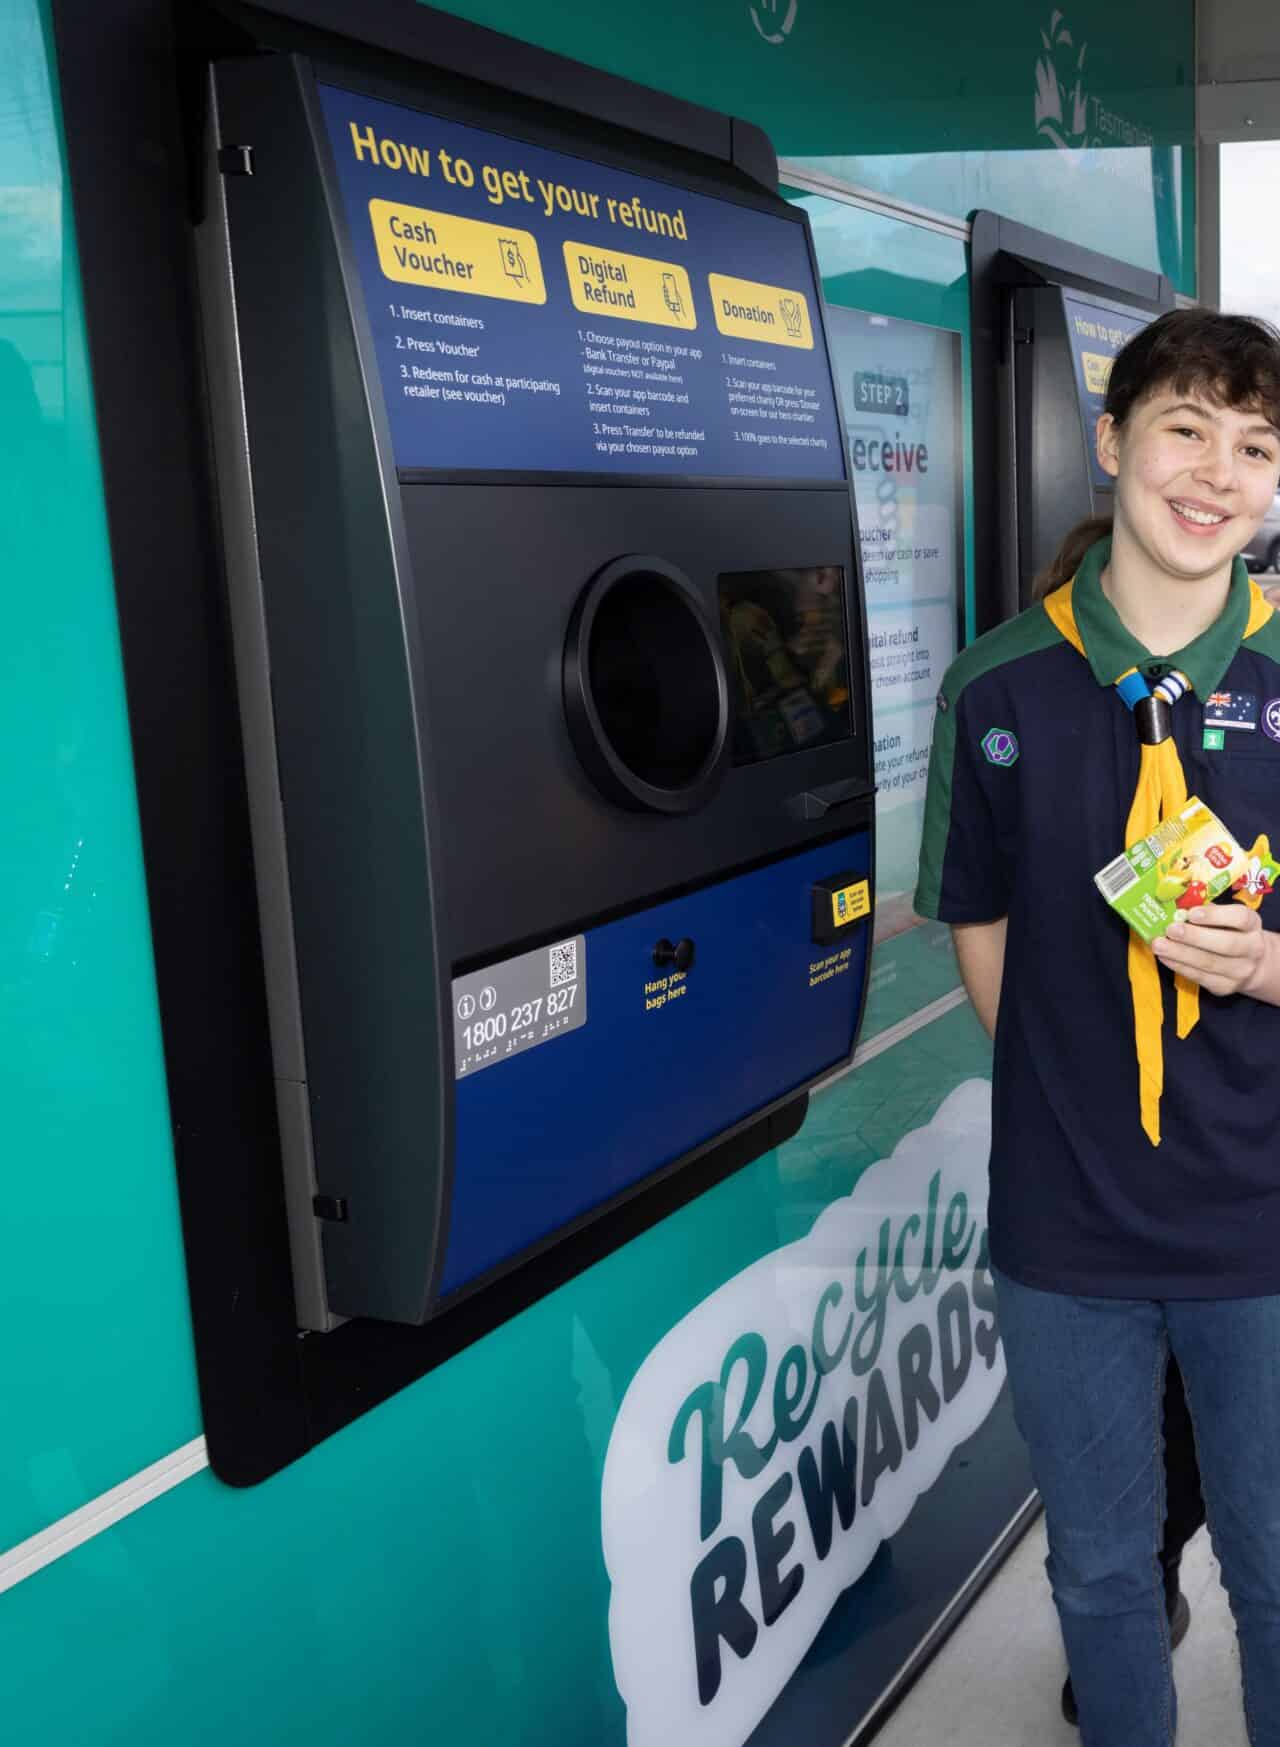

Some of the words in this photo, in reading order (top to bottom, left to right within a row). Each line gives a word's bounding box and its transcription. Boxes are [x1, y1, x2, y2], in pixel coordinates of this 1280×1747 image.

[350, 121, 430, 177] How
[438, 149, 475, 188] to
[482, 165, 534, 205] get
[537, 179, 600, 218] your
[607, 197, 687, 241] refund
[389, 216, 437, 245] Cash
[393, 245, 474, 280] Voucher
[578, 255, 628, 284] Digital
[584, 282, 636, 309] Refund
[389, 304, 400, 319] 1.
[401, 305, 432, 323] Insert
[433, 311, 485, 330] containers
[722, 299, 775, 325] Donation
[1075, 315, 1097, 338] How
[395, 336, 406, 350] 2.
[407, 337, 435, 353] Press
[577, 330, 586, 341] 1.
[586, 331, 616, 346] Choose
[616, 337, 640, 351] payout
[585, 347, 607, 361] Bank
[607, 350, 640, 366] Transfer
[400, 365, 411, 378] 3.
[412, 366, 454, 384] Redeem
[455, 370, 470, 384] for
[471, 373, 493, 387] cash
[495, 376, 504, 387] at
[505, 378, 561, 396] participating
[404, 385, 441, 399] retailer
[442, 387, 463, 402] (see
[464, 390, 507, 406] voucher)
[586, 383, 595, 395] 2.
[595, 384, 614, 396] Scan
[614, 388, 631, 400] your
[632, 389, 647, 402] app
[647, 390, 675, 403] barcode
[676, 392, 689, 404] and
[861, 381, 891, 405] STEP
[896, 387, 904, 406] 2
[612, 403, 650, 417] containers
[592, 423, 601, 435] 3.
[602, 423, 624, 436] Press
[675, 429, 705, 441] refunded
[608, 442, 625, 456] your
[626, 440, 651, 454] chosen
[652, 444, 676, 457] payout
[676, 446, 698, 456] option
[851, 433, 928, 473] eceive
[860, 529, 891, 542] oucher
[889, 626, 919, 646] refund
[874, 733, 901, 753] nation
[645, 978, 668, 995] Hang
[646, 994, 666, 1010] bags
[668, 985, 687, 1001] here
[462, 1013, 508, 1050] 1800
[511, 998, 543, 1032] 237
[546, 984, 578, 1017] 827
[668, 1168, 976, 1541] Recycle
[690, 1228, 1002, 1707] REWARDS
